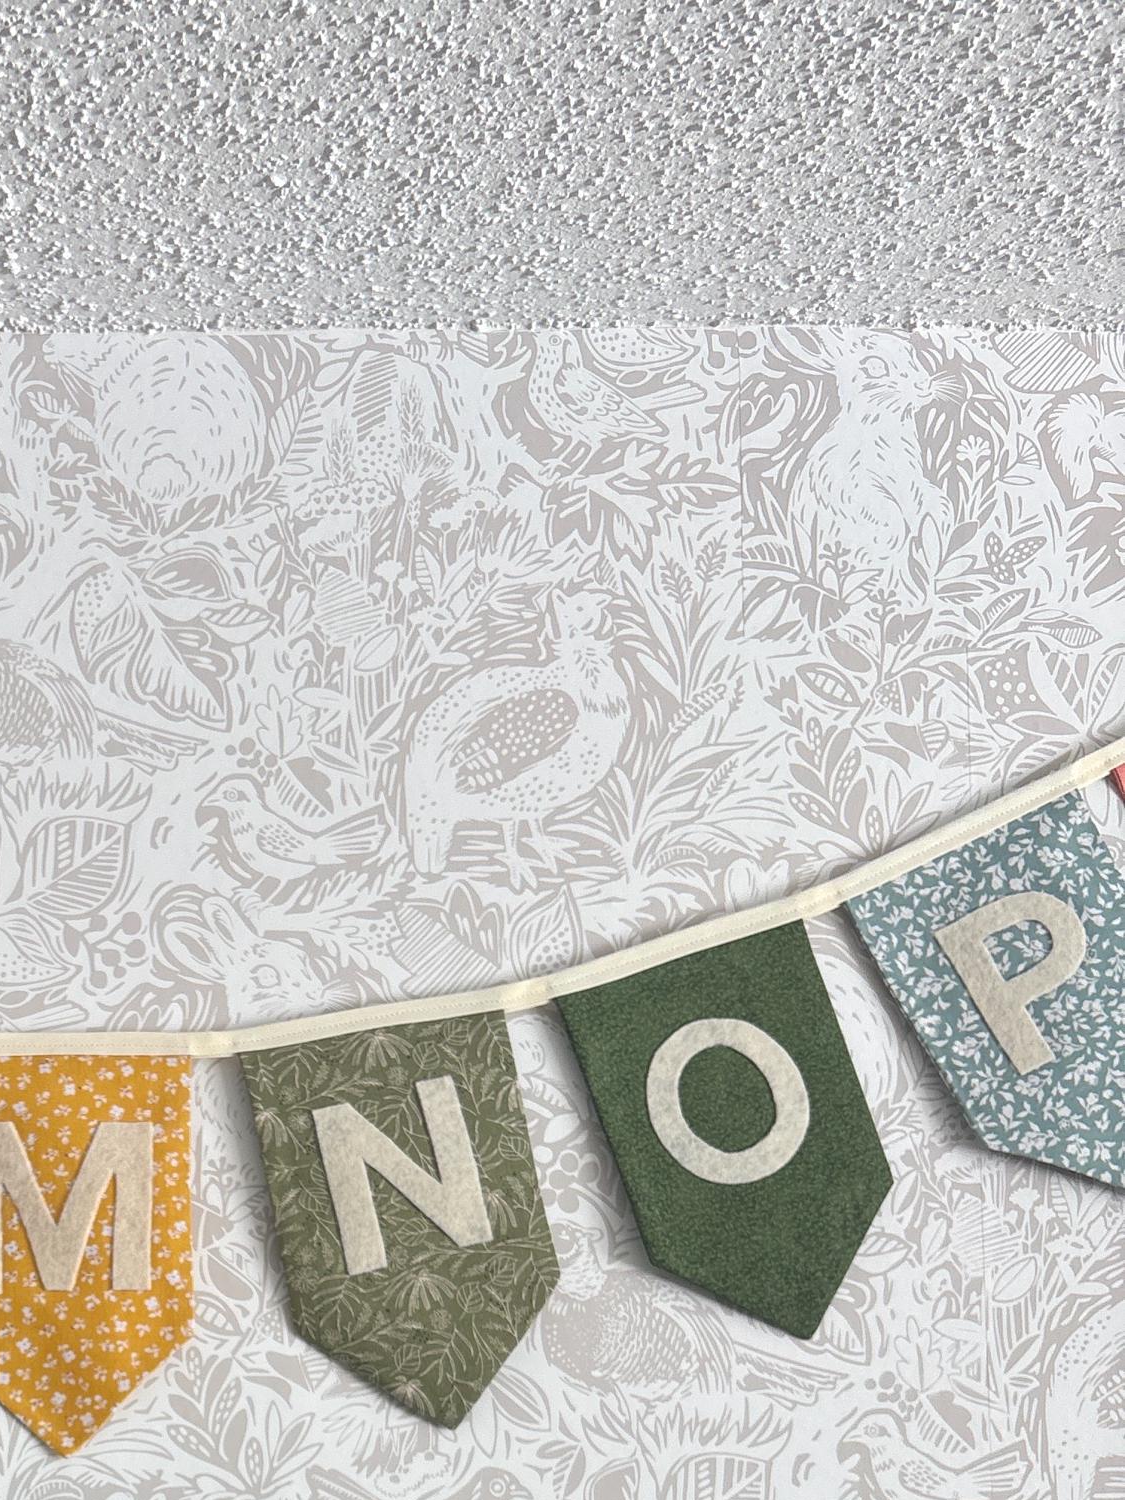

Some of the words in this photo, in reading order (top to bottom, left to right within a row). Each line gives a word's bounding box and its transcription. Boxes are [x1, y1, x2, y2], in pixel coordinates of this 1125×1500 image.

[312, 1076, 494, 1276] N
[645, 1017, 810, 1186] O
[934, 891, 1087, 1075] P
